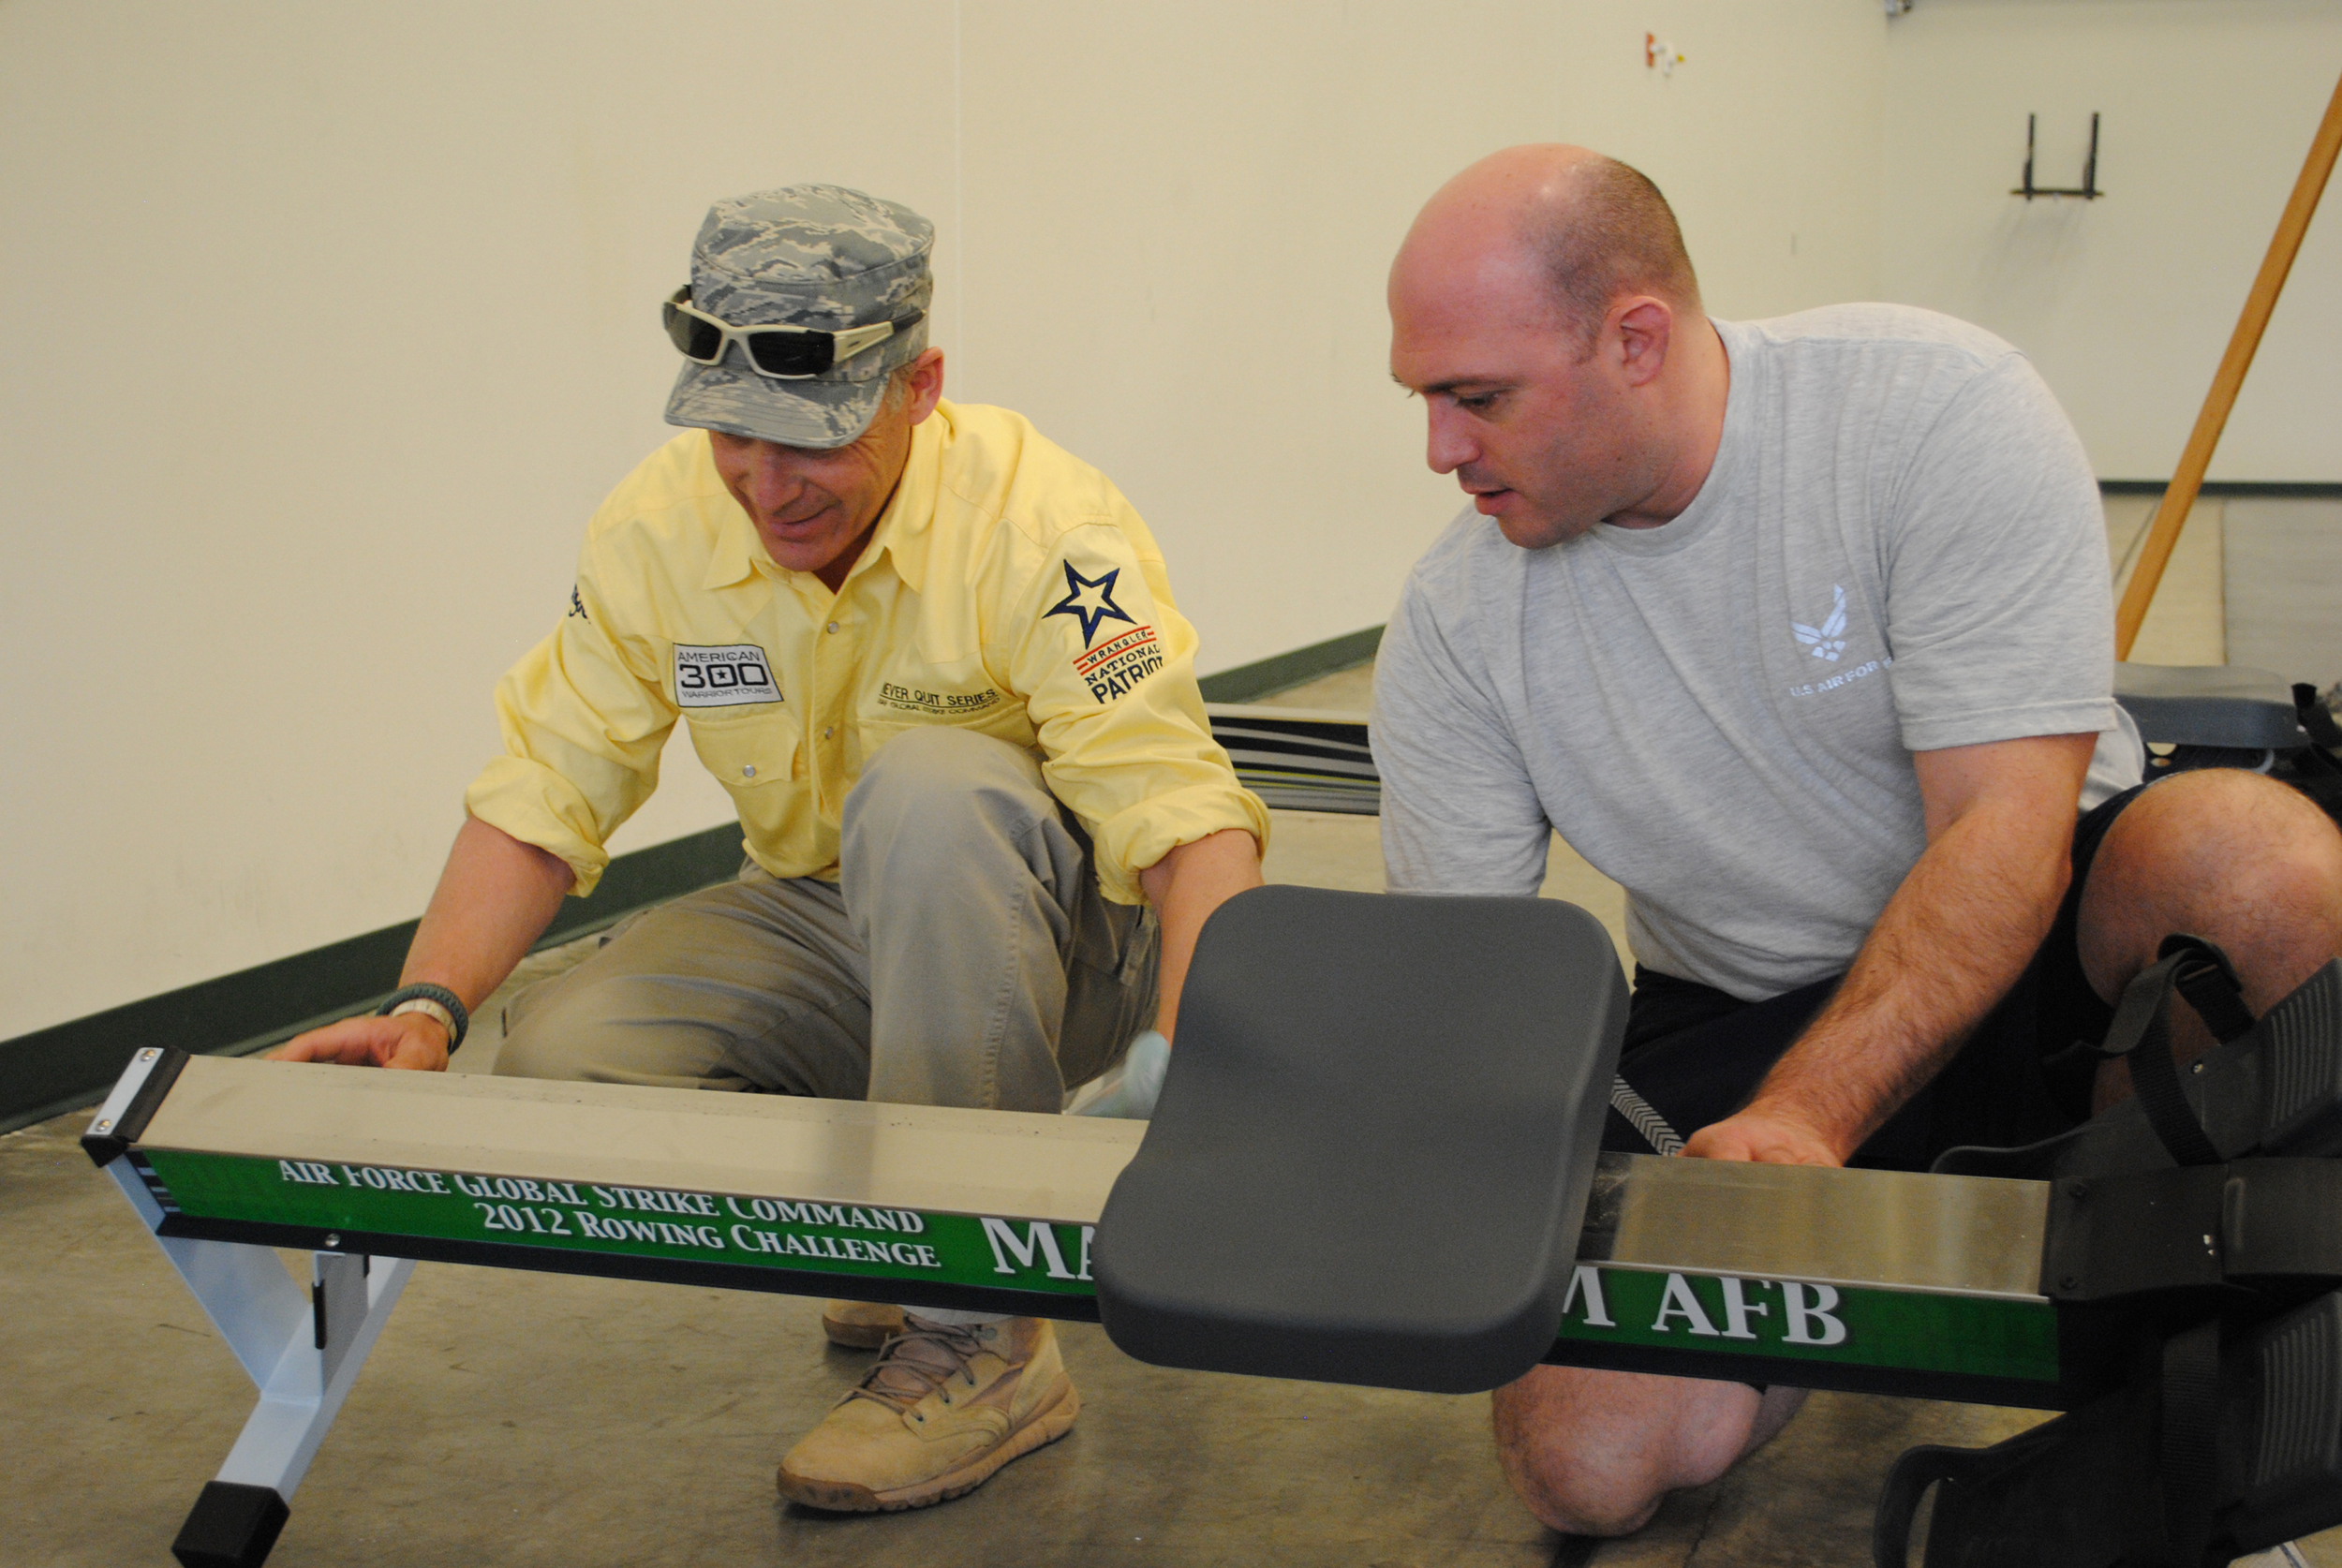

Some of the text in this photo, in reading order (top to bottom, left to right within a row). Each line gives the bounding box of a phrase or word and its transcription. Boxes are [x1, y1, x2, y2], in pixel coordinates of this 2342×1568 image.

[677, 651, 761, 663] AMERICAN
[1087, 629, 1149, 664] WRANGLER
[679, 662, 769, 688] 300
[1084, 644, 1161, 687] NATIONAL
[682, 687, 774, 699] WARRIOR TOURS
[881, 682, 996, 706] EVER QUIT SERIES
[1816, 675, 1844, 693] AIR
[278, 1160, 925, 1234] AIR FORCE GLOBAL STRIKE COMMAND
[473, 1202, 942, 1268] 2012 ROWING CHALLENGE
[1651, 1271, 1850, 1347] AFB
